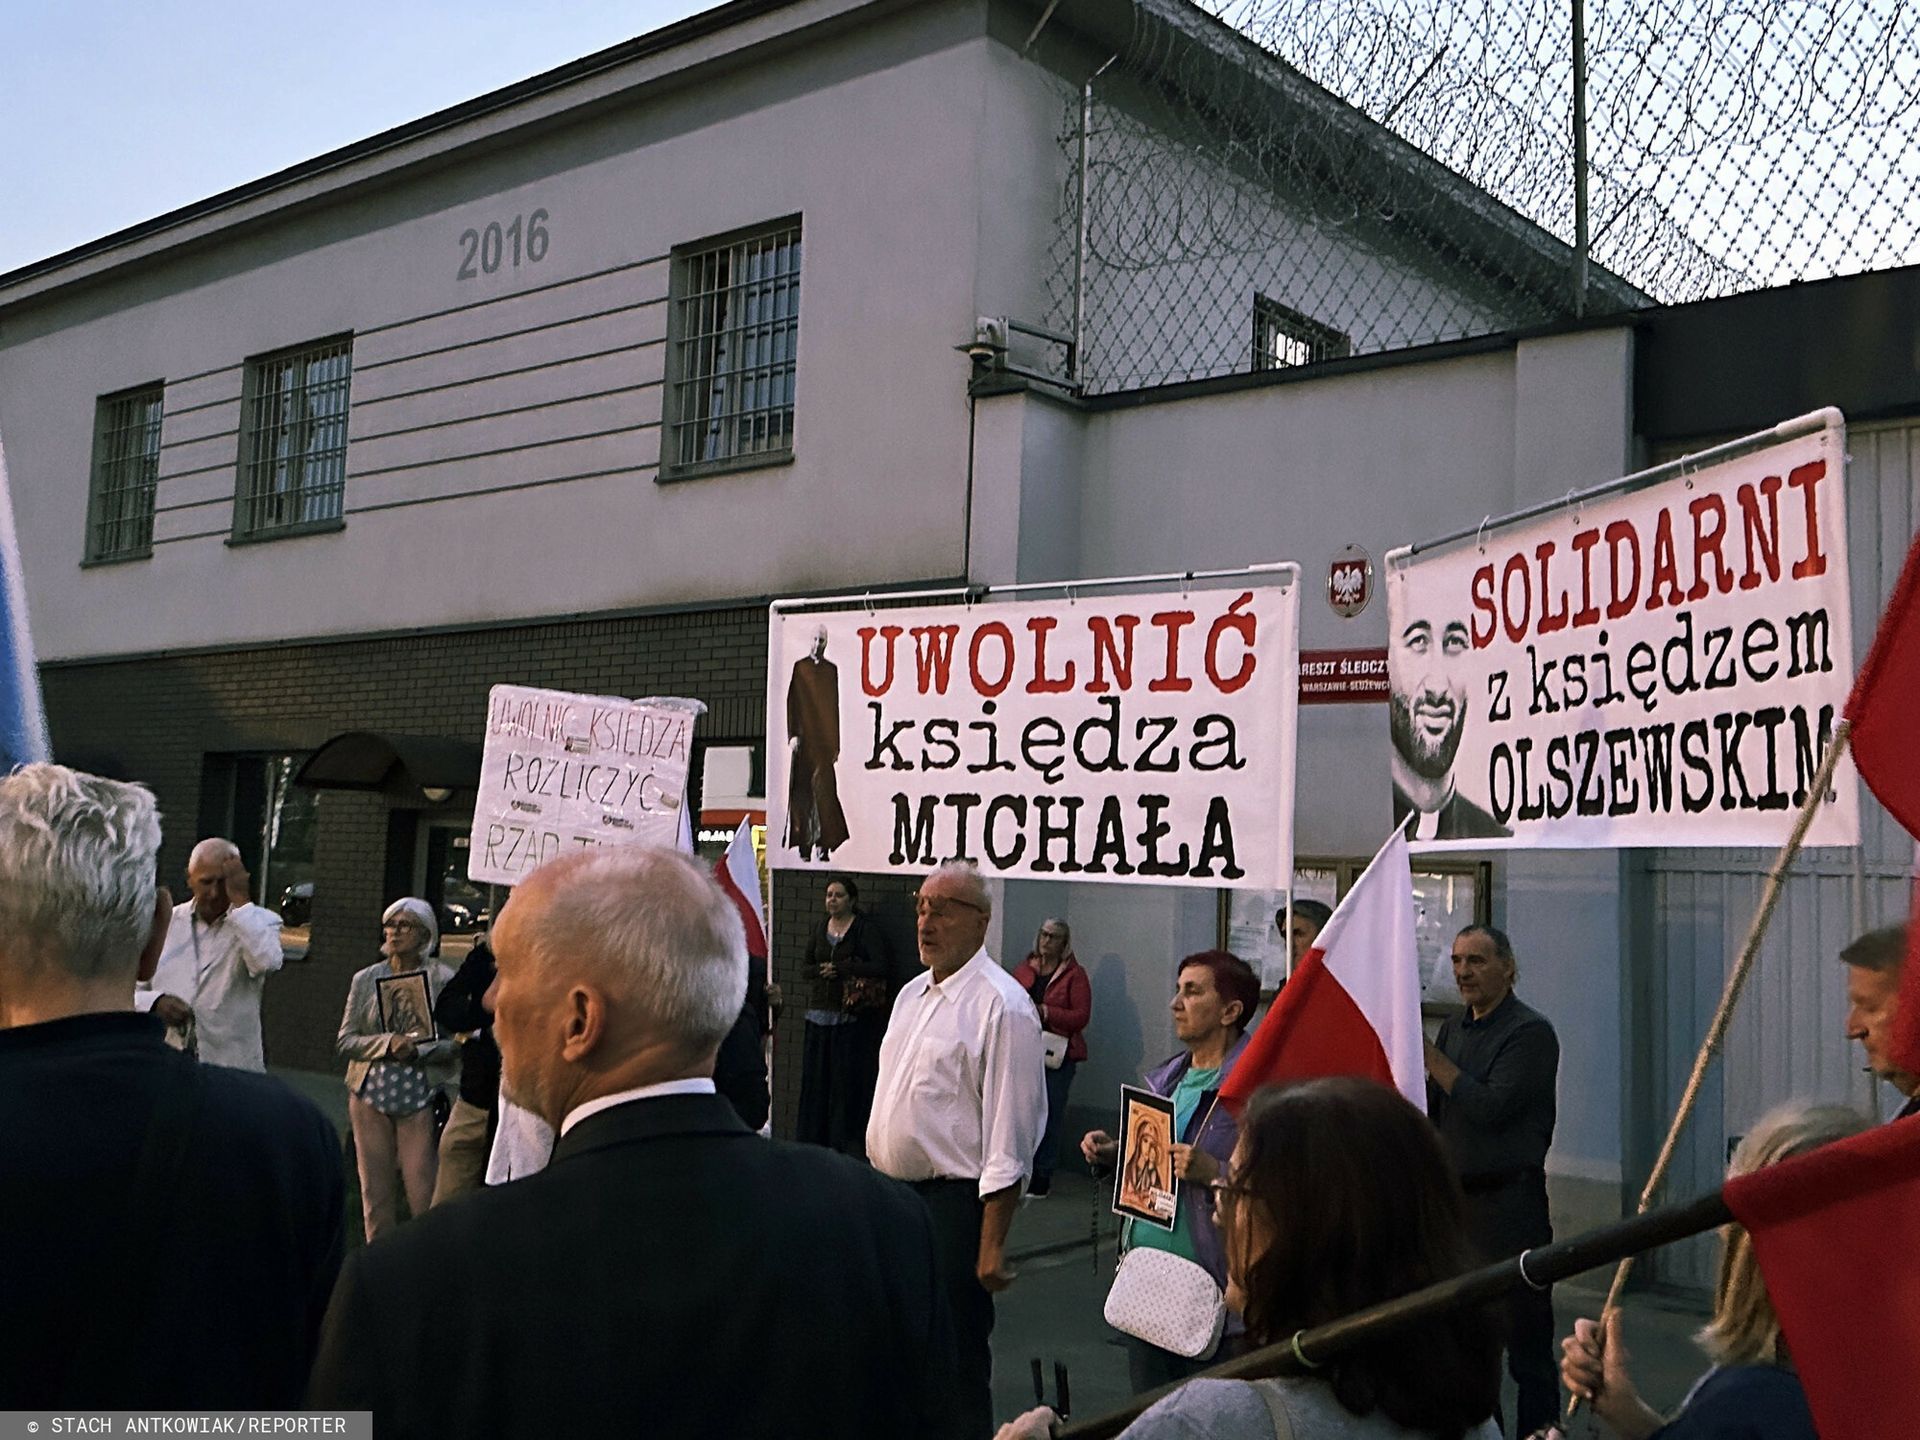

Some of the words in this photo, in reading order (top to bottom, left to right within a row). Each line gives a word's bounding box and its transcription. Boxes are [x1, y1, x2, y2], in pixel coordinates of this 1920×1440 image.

[456, 208, 549, 281] 2016
[1470, 459, 1827, 650] SOLIDARNI
[857, 591, 1258, 697] UWOLNIĆ
[1299, 662, 1337, 676] RESZT
[1488, 671, 1512, 722] z
[1526, 606, 1834, 713] księdzem
[864, 695, 1247, 785] księdza
[1488, 703, 1837, 825] OLSZEWSKIM
[889, 793, 1246, 880] MICHAŁA
